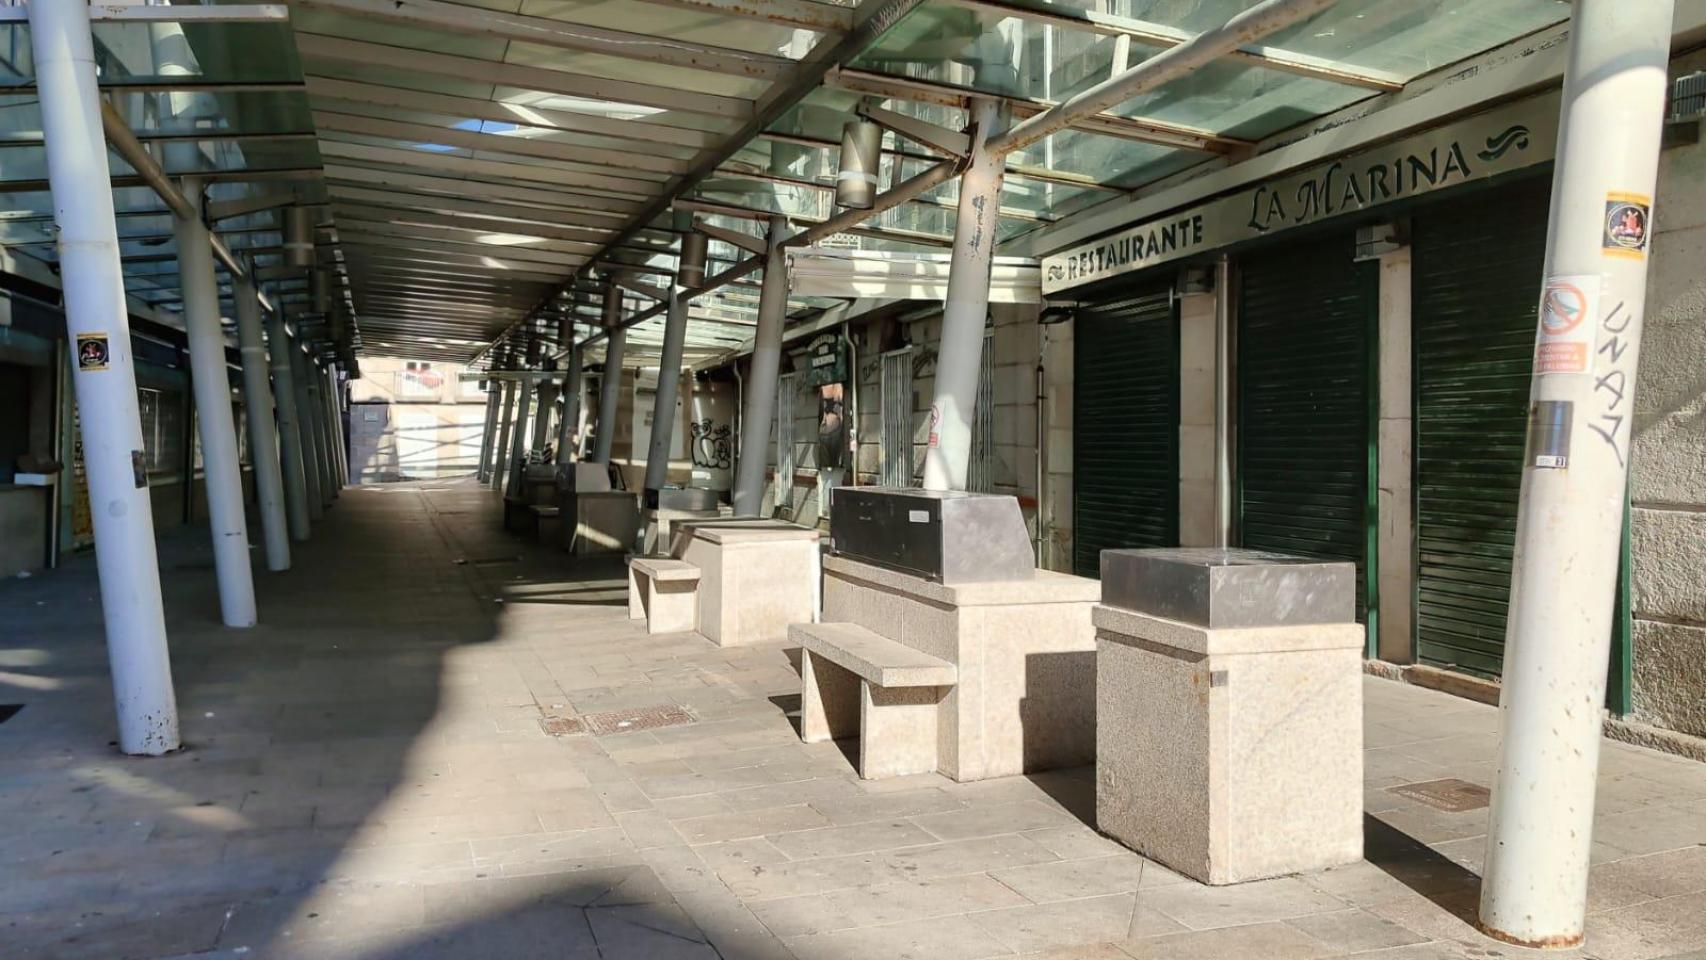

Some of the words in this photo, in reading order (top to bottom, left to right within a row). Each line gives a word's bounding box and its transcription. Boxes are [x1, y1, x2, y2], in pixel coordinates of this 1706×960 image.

[1068, 214, 1203, 281] RESTAURANTE
[1248, 186, 1286, 231] LA
[1295, 141, 1472, 223] MARINA
